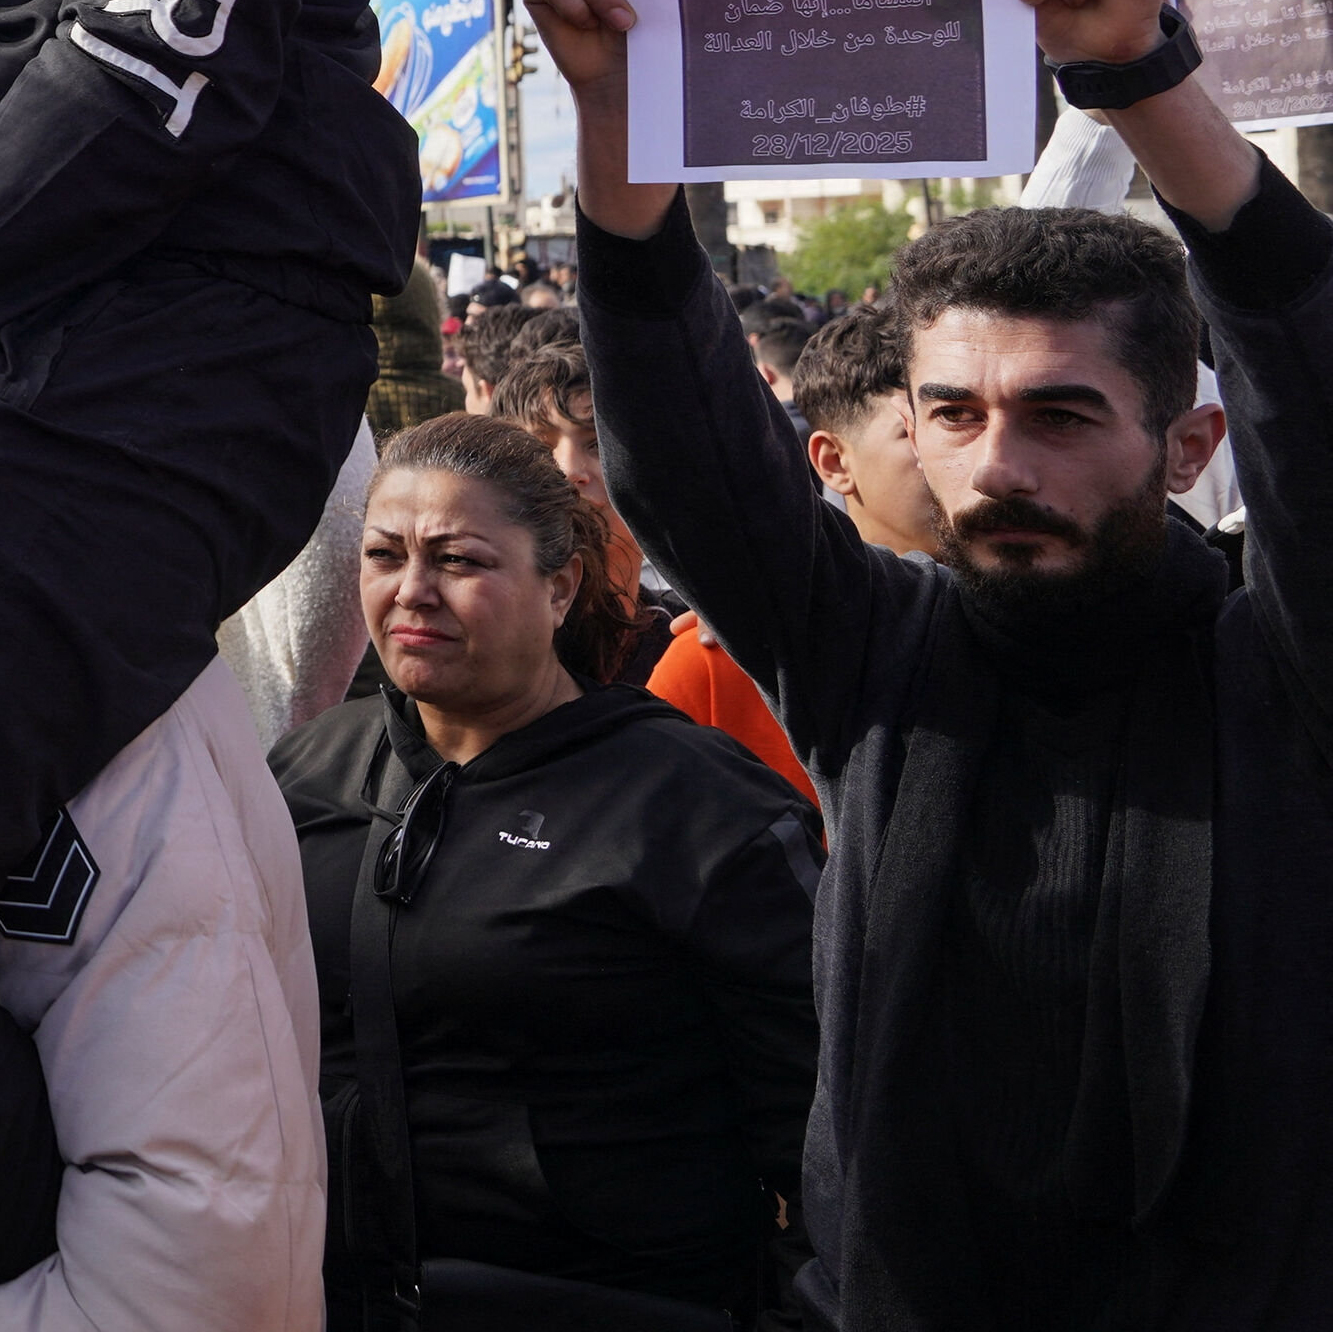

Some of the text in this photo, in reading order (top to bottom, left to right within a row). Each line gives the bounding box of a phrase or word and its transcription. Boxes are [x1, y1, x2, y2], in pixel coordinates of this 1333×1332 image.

[704, 21, 961, 55] للوحدة من خلال العدالة
[739, 95, 926, 124] #طوفان_الكرامة
[752, 131, 912, 158] 28/12/2025
